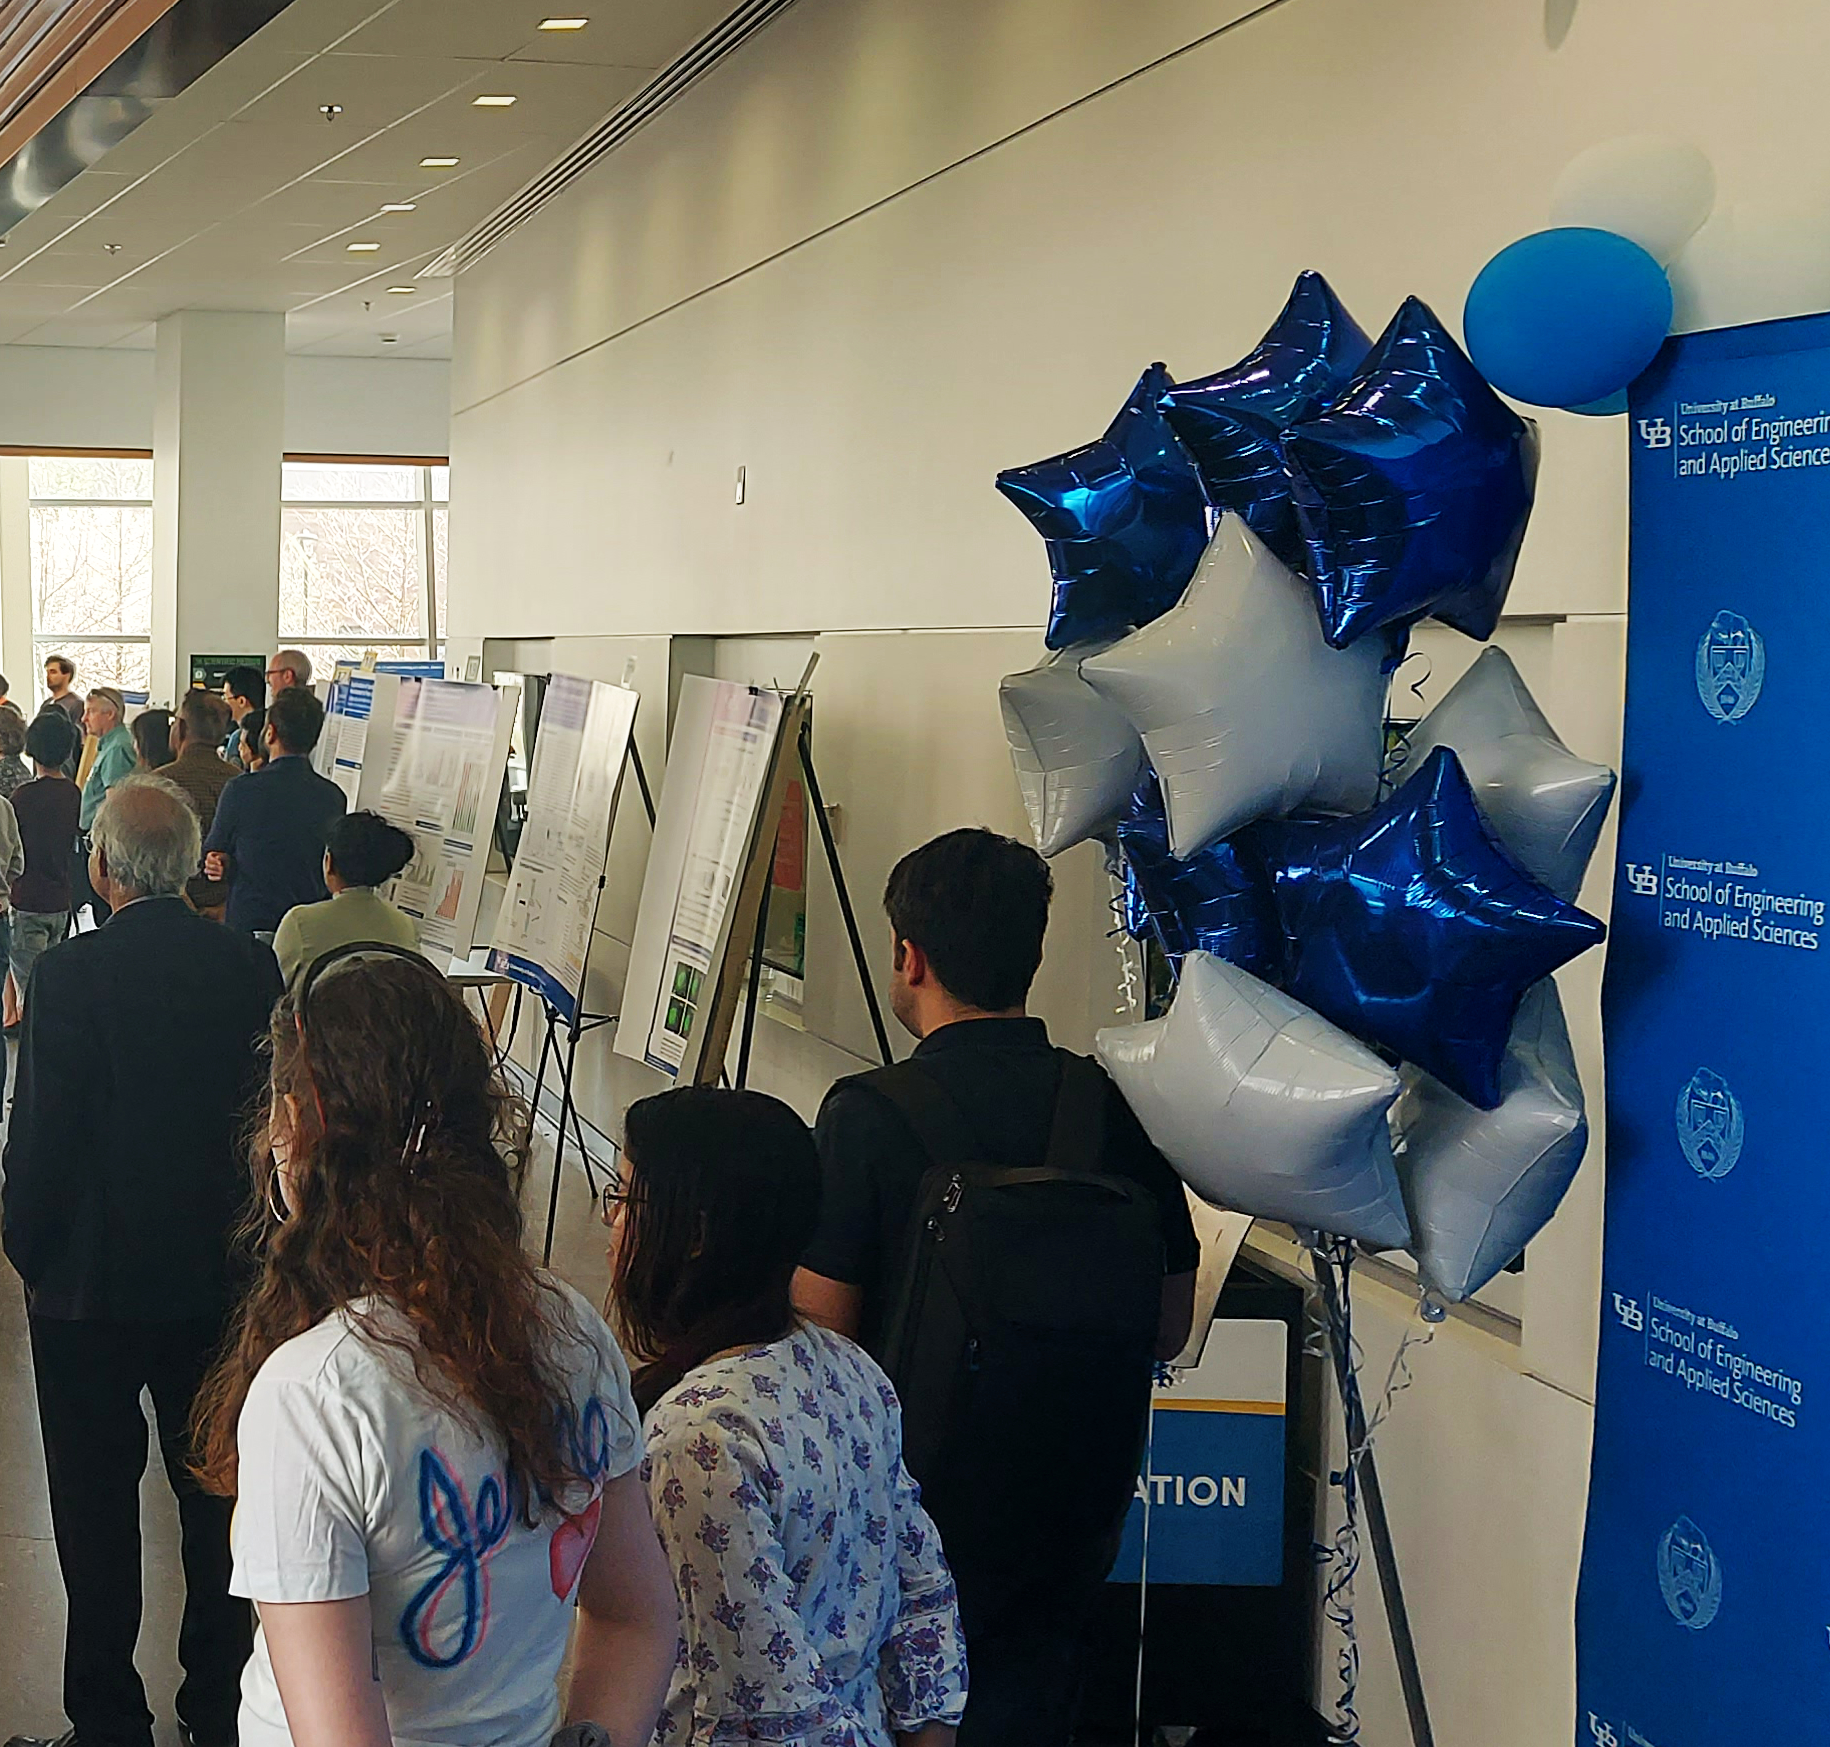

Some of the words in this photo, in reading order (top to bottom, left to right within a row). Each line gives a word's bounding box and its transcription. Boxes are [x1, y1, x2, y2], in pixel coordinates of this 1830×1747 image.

[1637, 417, 1672, 448] UB
[1679, 420, 1728, 446] School
[1731, 417, 1750, 442] of
[1679, 451, 1706, 476] and
[1709, 446, 1768, 480] Applied
[1625, 863, 1658, 896] UB
[1665, 877, 1713, 904] School
[1715, 883, 1733, 906] of
[1734, 887, 1826, 927] Engineering
[1664, 907, 1690, 930] and
[1693, 911, 1749, 941] Applied
[1752, 918, 1819, 950] Sciences
[1612, 1292, 1644, 1332] UB
[1651, 1317, 1695, 1354] School
[1698, 1338, 1714, 1361] of
[1716, 1344, 1803, 1406] Engineering
[1649, 1350, 1674, 1375] and
[1676, 1358, 1730, 1400] Applied
[1733, 1381, 1796, 1429] Sciences
